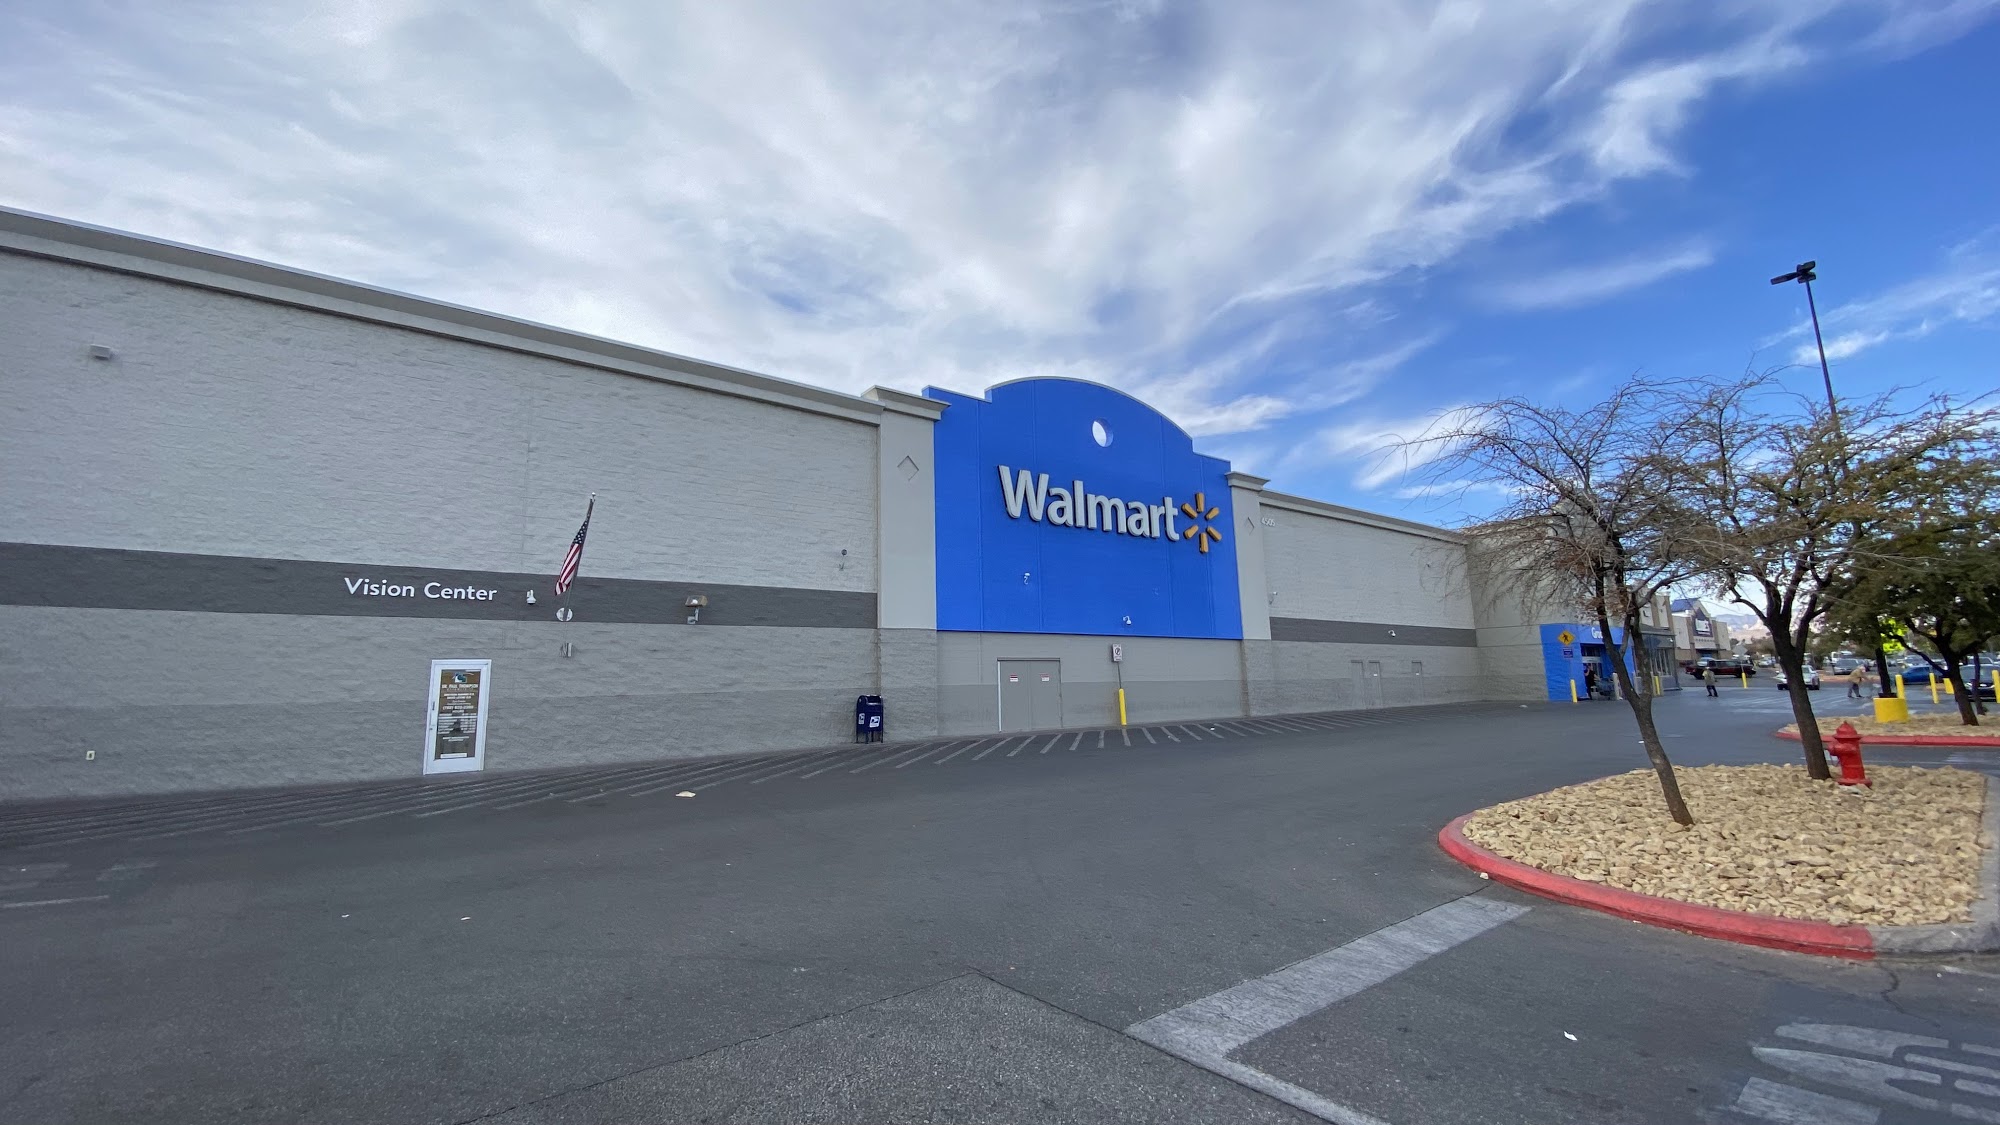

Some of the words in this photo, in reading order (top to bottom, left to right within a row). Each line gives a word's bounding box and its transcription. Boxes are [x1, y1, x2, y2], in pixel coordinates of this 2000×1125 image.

[998, 464, 1180, 541] Walmart
[344, 577, 415, 597] Vision
[424, 582, 498, 600] Center
